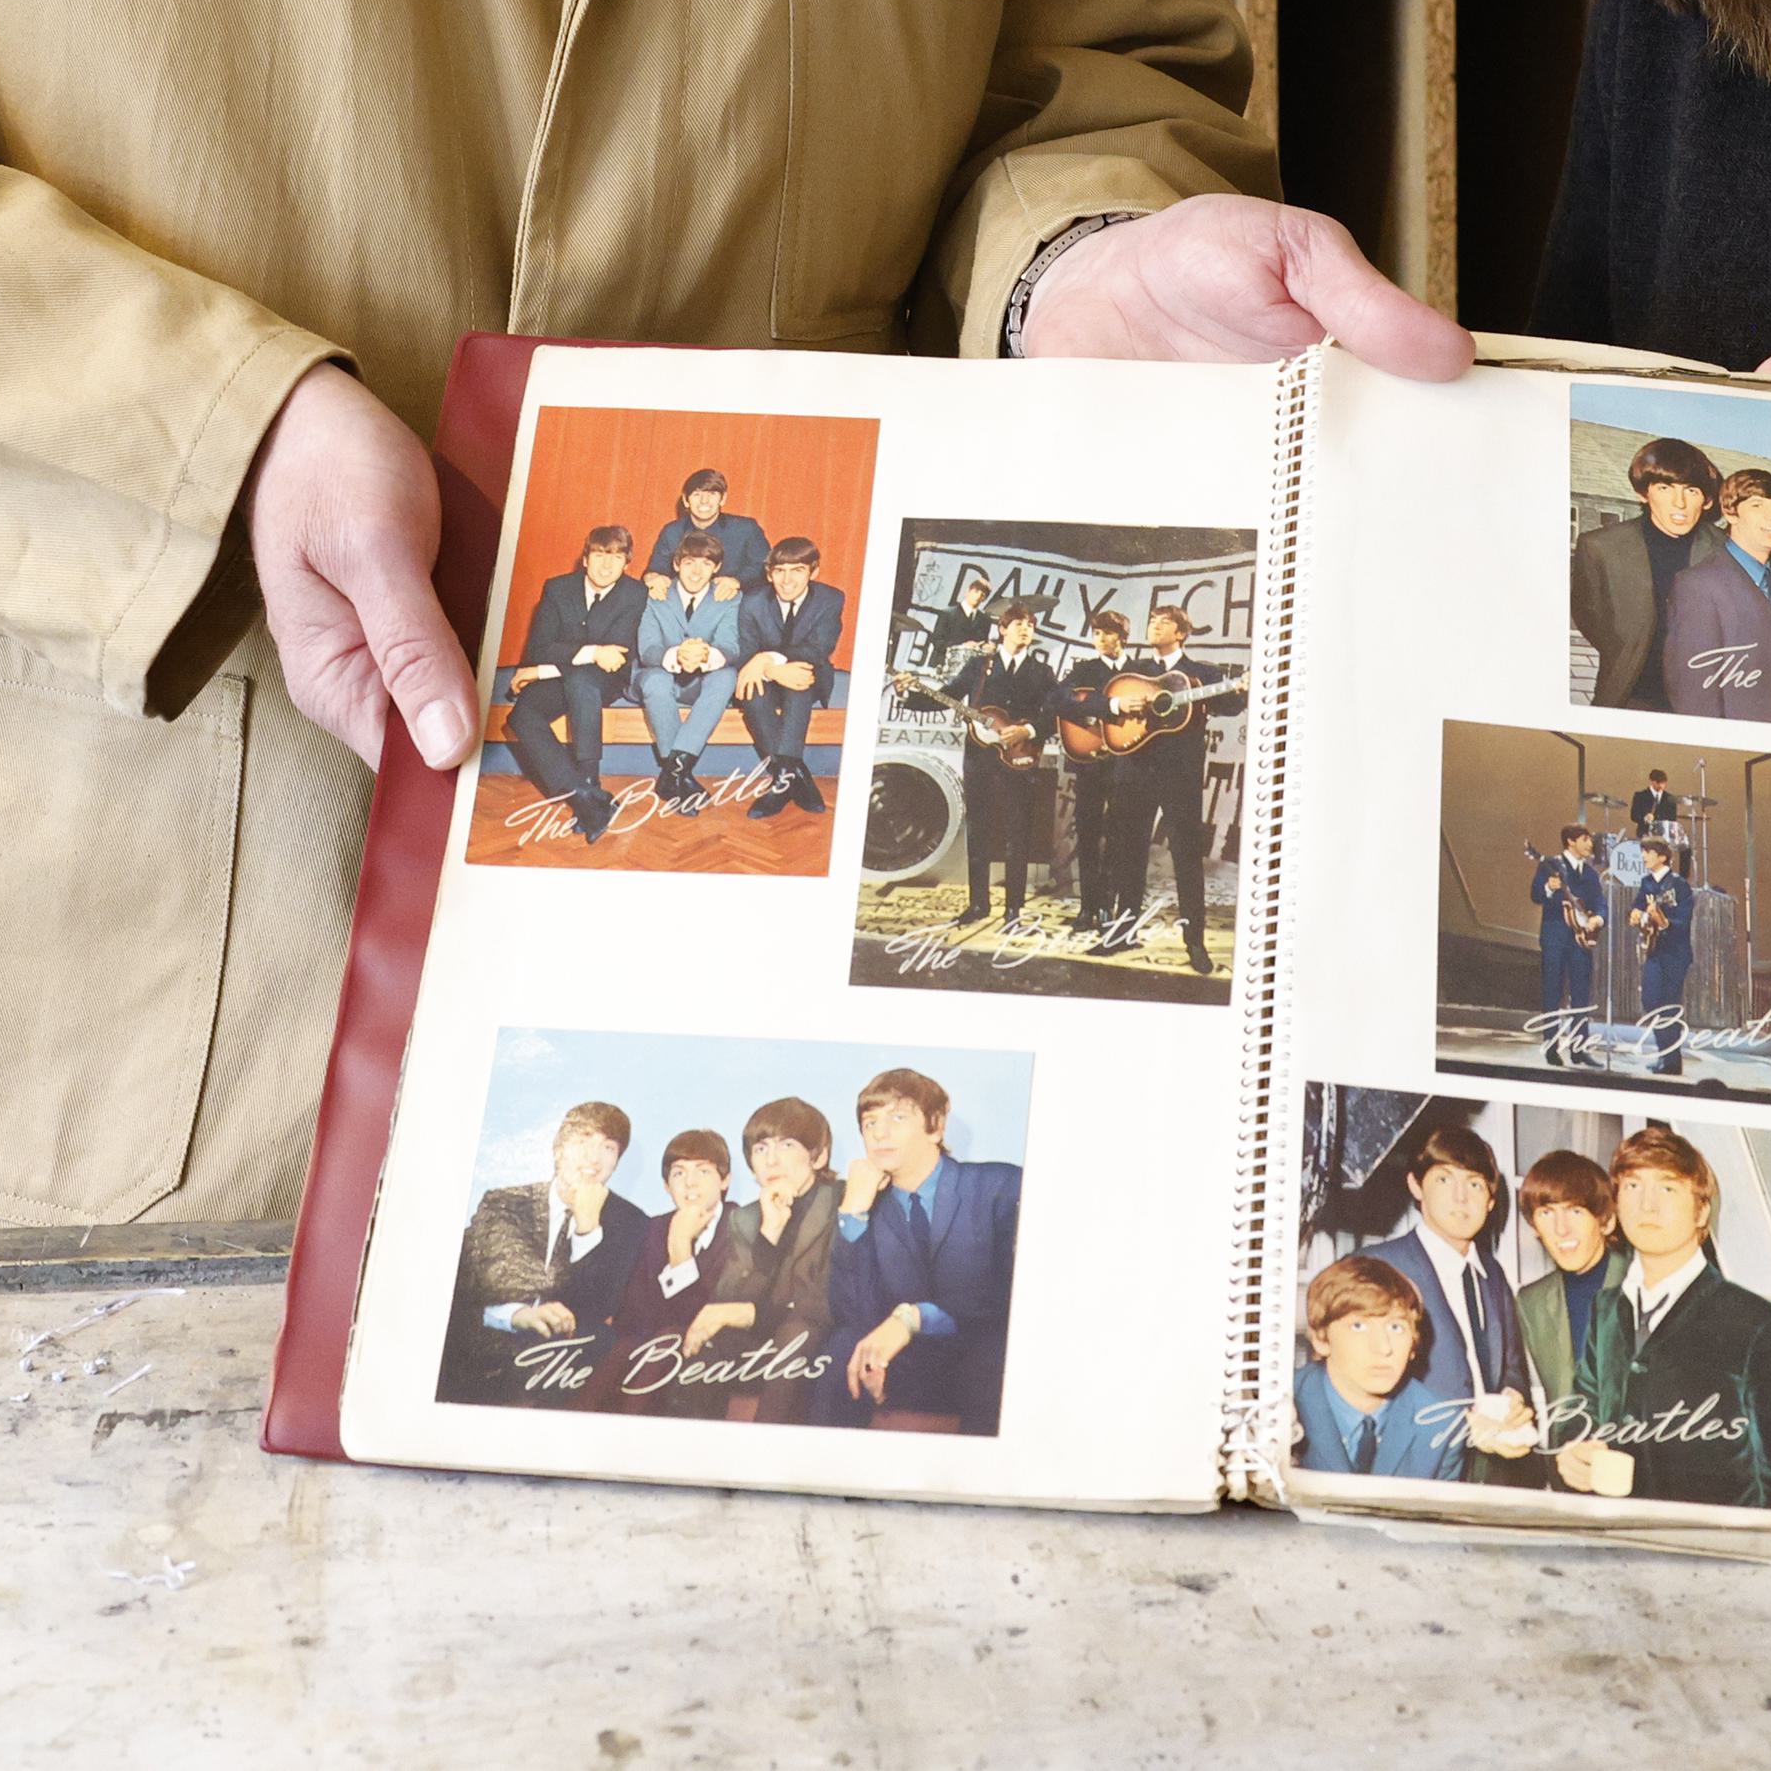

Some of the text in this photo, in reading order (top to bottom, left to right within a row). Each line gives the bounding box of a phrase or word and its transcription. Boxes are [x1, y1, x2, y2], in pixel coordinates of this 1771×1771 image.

[1688, 642, 1763, 690] The
[504, 754, 796, 847] The Beatles
[885, 919, 961, 975] The
[991, 897, 1190, 970] Beatles
[1524, 1004, 1605, 1055] The
[514, 1329, 833, 1396] The Beatles
[1534, 1391, 1750, 1455] Beatles
